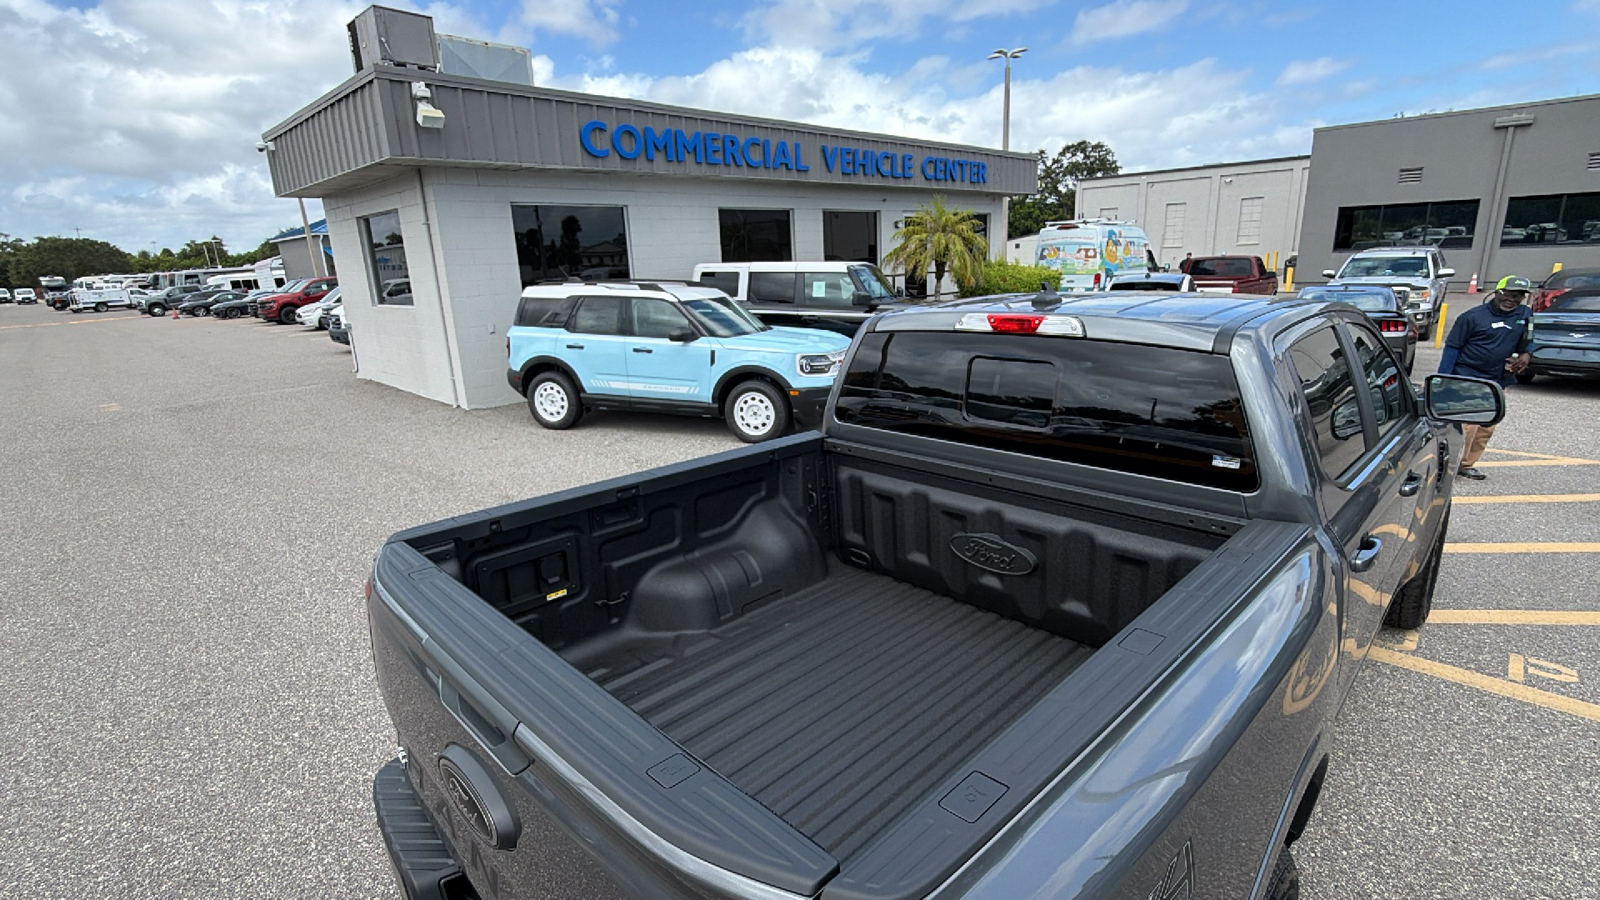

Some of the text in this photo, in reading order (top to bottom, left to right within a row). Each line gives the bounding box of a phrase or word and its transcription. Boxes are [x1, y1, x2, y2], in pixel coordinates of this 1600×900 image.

[580, 120, 988, 184] COMMERCIAL VEHICLE CENTER
[964, 537, 1016, 570] Ford
